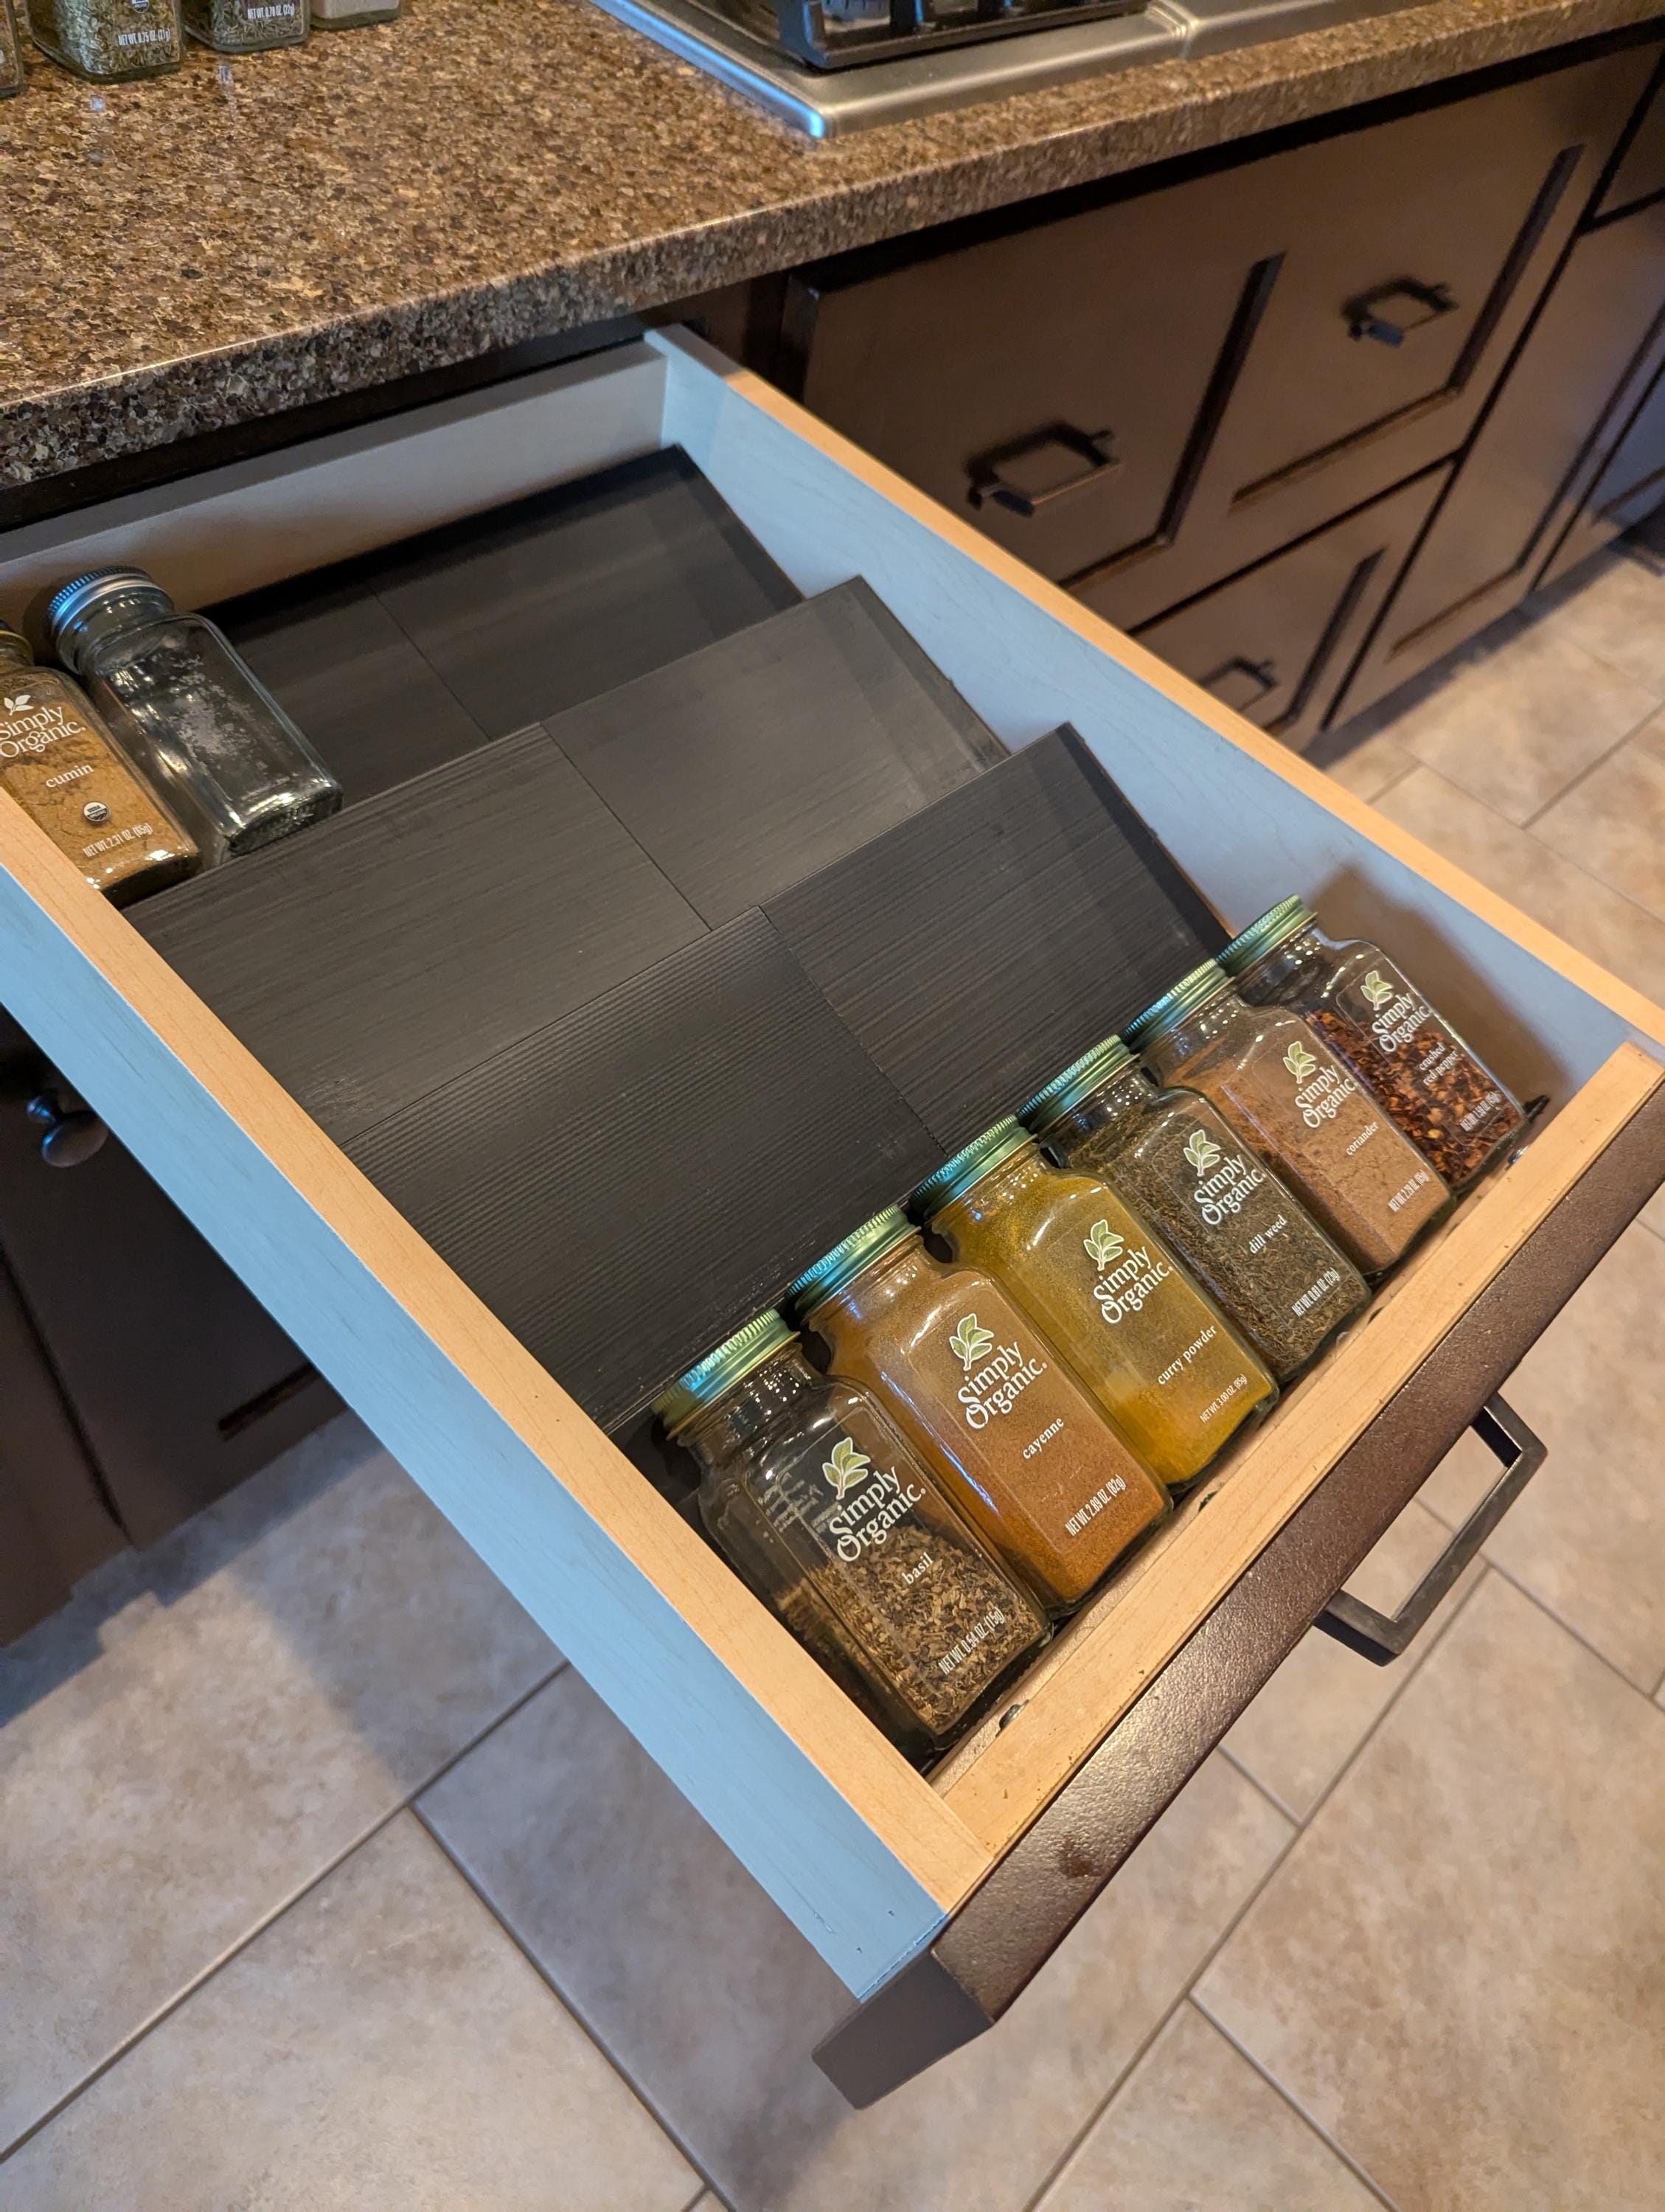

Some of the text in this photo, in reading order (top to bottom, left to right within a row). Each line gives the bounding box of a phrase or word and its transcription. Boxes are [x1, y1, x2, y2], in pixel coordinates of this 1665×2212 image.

[248, 8, 257, 19] NET
[118, 34, 128, 46] NET
[46, 765, 94, 787] cumin
[83, 844, 99, 858] NET
[106, 834, 124, 847] 2.31
[1372, 992, 1415, 1034] Simply
[1419, 1042, 1445, 1071] crushed
[1423, 1050, 1458, 1085] red pepper
[1295, 1065, 1340, 1109] Simply
[1346, 1121, 1379, 1155] coriander
[1195, 1155, 1246, 1203] Simply
[1249, 1214, 1287, 1253] dill weed
[1093, 1246, 1152, 1301] Simply
[1292, 1301, 1307, 1317] NET
[1307, 1284, 1323, 1301] 0.81
[958, 1341, 1023, 1404] Simply
[1158, 1326, 1217, 1385] curry powder
[1199, 1408, 1212, 1423] NET
[1216, 1392, 1229, 1406] 3.00
[1023, 1418, 1064, 1459] cayenne
[829, 1466, 900, 1534] Simply
[1065, 1517, 1082, 1537] NET
[1085, 1497, 1103, 1517] 2.89
[1106, 1474, 1127, 1497] (82g)
[901, 1551, 934, 1585] basil
[938, 1654, 956, 1675] NET
[962, 1632, 980, 1653] 0.54
[984, 1606, 1004, 1632] (15g)
